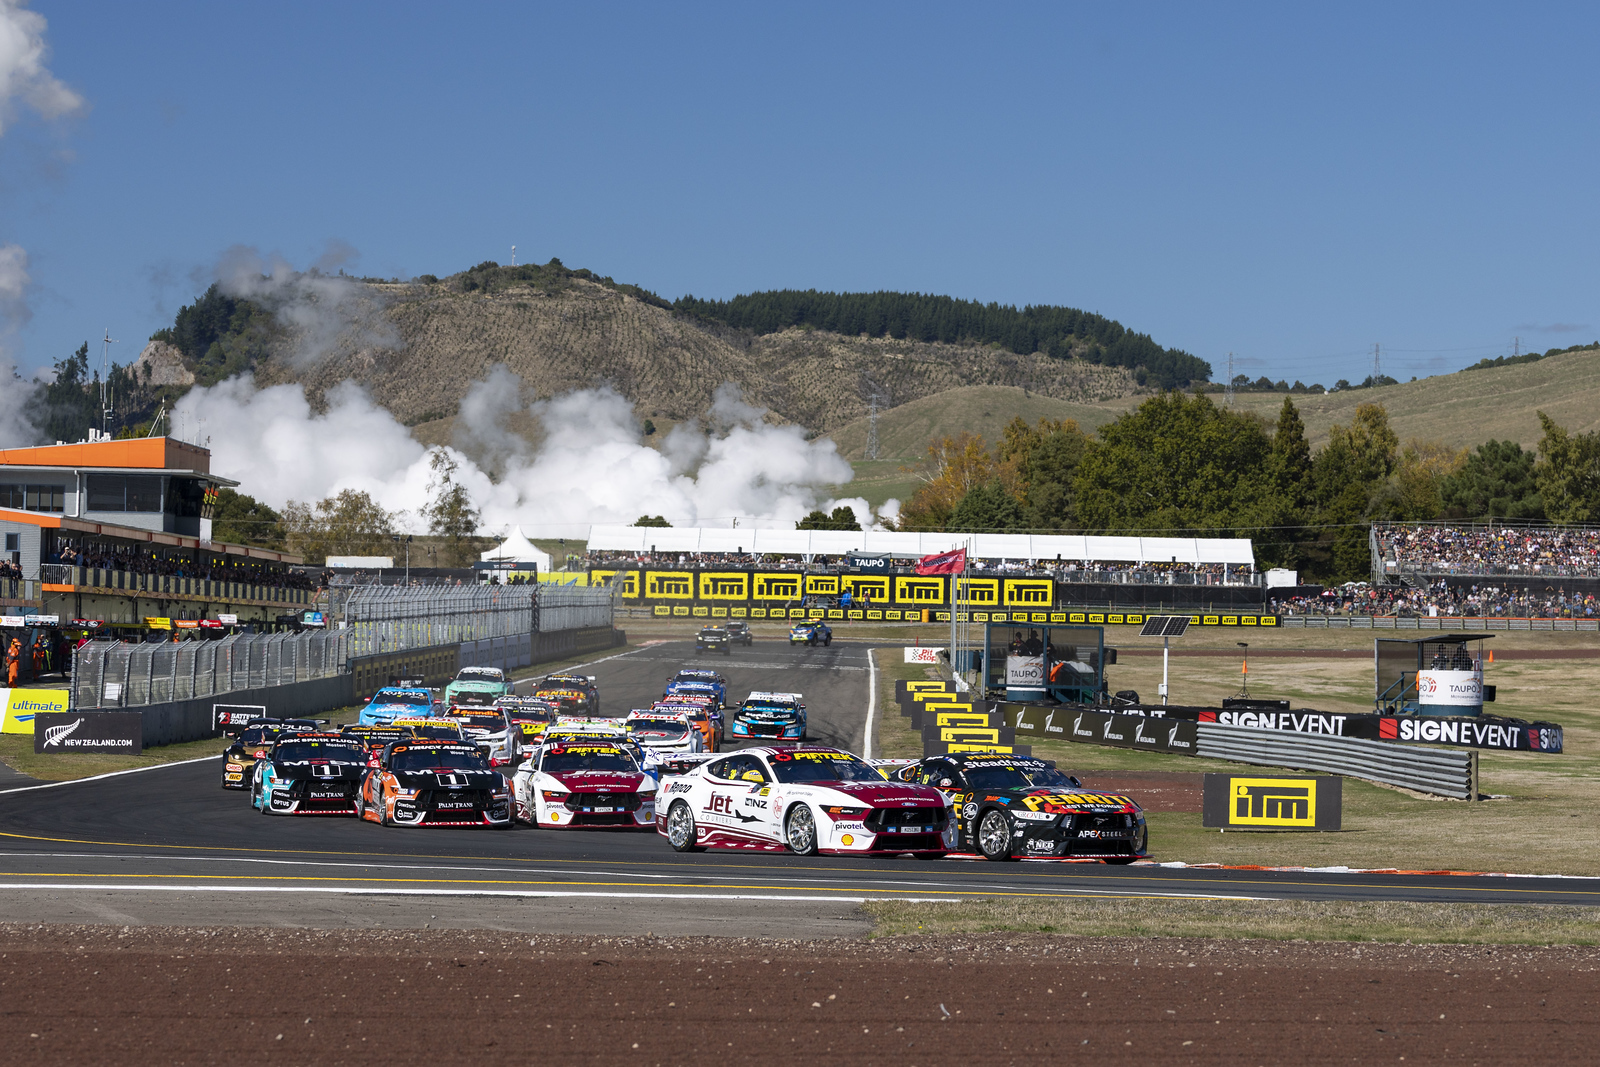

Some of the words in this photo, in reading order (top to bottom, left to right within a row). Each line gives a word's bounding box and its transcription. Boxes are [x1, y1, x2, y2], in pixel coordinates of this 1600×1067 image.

[702, 574, 746, 598] itm
[898, 580, 942, 602] itm
[1006, 582, 1050, 604] itm
[13, 700, 62, 711] ultimate
[964, 760, 1034, 768] Steadfast
[321, 765, 330, 775] 1
[446, 774, 457, 784] 1
[1233, 782, 1312, 822] itm
[700, 814, 732, 825] COURIERS
[1078, 830, 1102, 840] APEX
